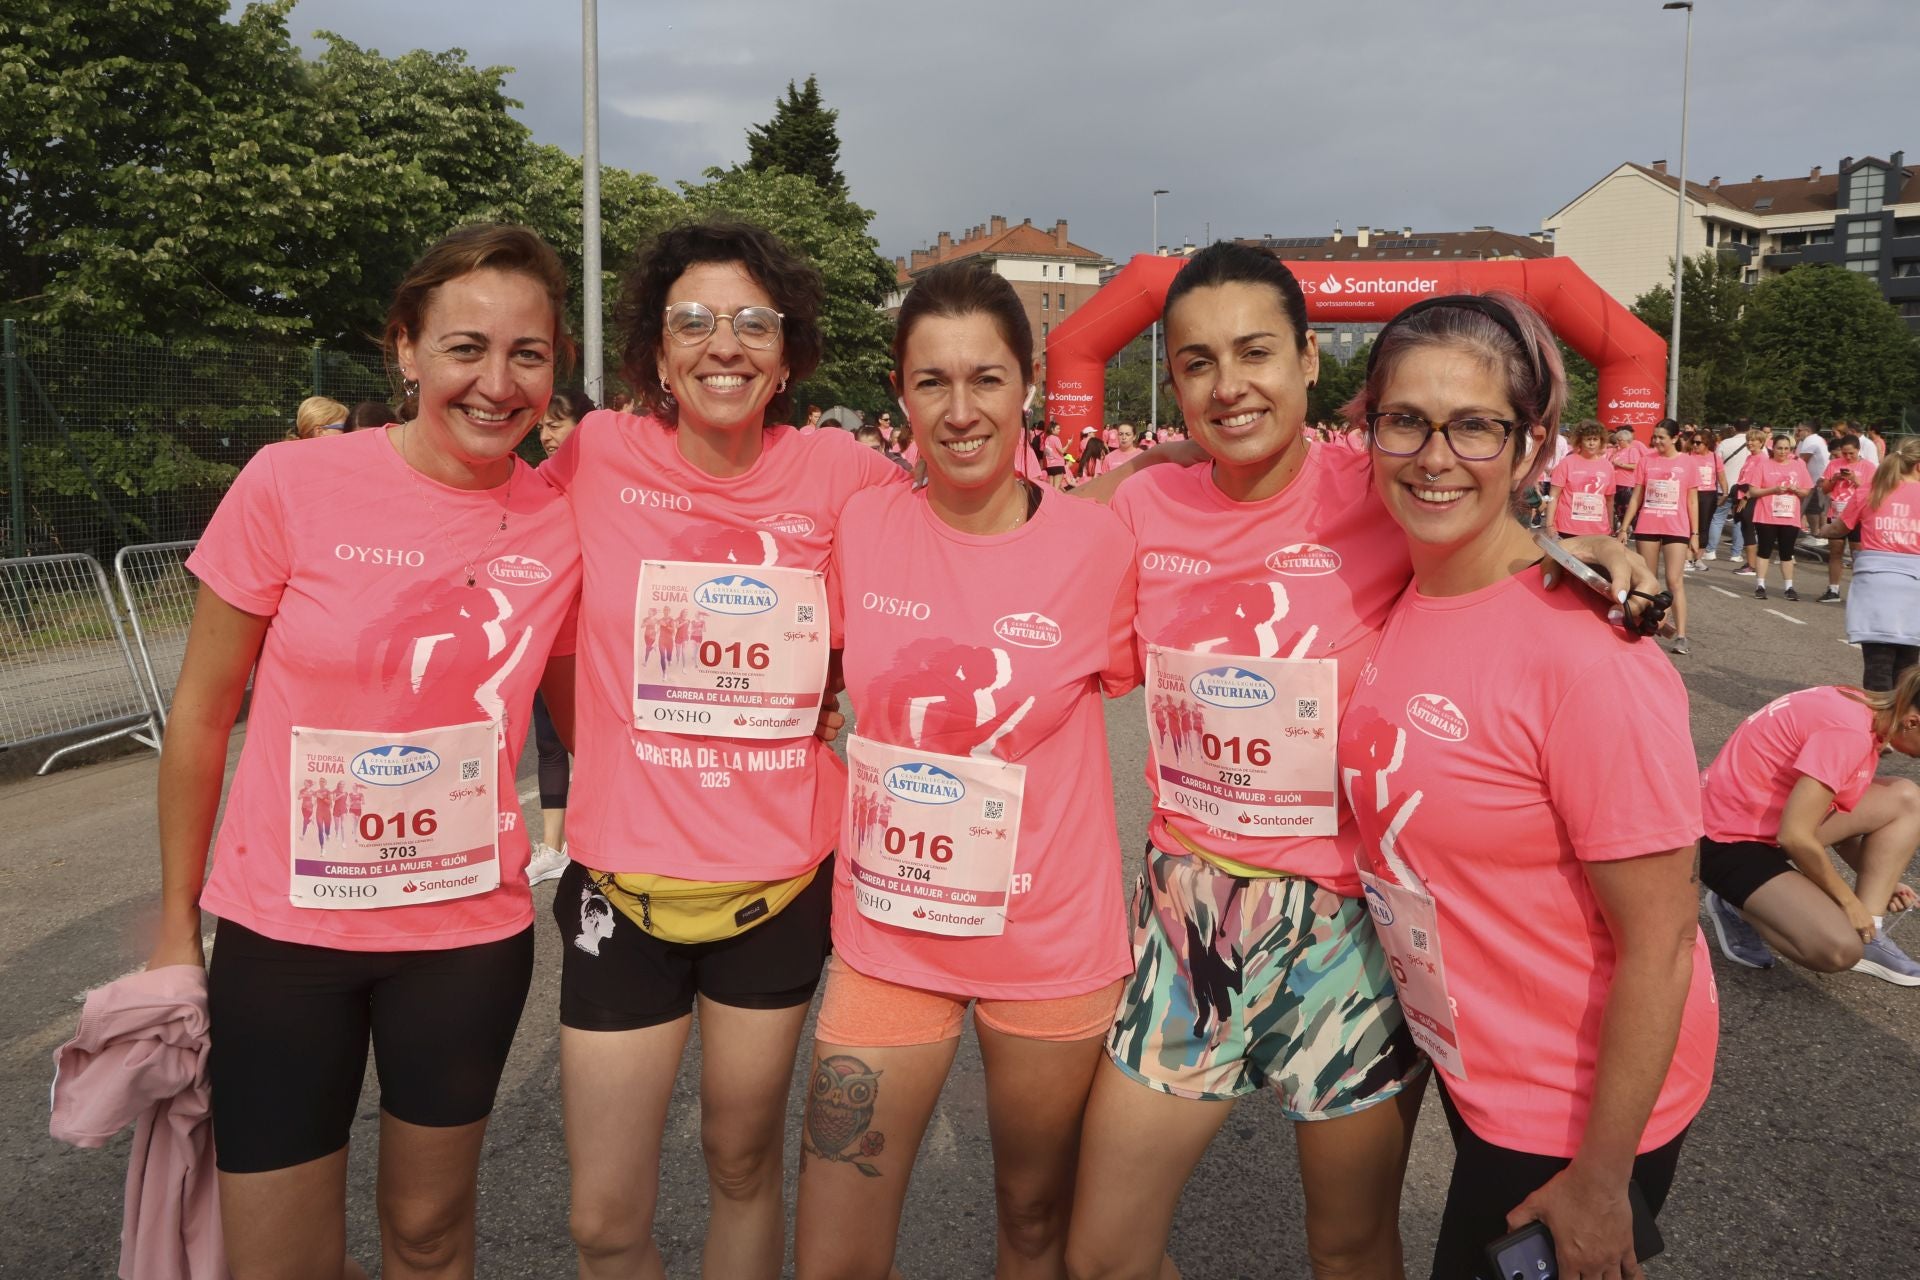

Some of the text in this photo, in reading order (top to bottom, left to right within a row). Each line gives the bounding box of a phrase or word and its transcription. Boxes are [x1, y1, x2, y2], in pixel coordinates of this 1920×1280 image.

[1345, 277, 1438, 294] Santander
[1057, 381, 1082, 389] Sports
[1622, 386, 1651, 396] Sports
[1055, 393, 1093, 402] Santander
[1619, 401, 1661, 409] Santander
[620, 487, 692, 512] OYSHO
[1891, 502, 1910, 517] TU
[1882, 531, 1917, 546] SUMA
[335, 544, 424, 567] OYSHO
[1143, 552, 1211, 575] OYSHO
[1272, 555, 1336, 569] ASTURIANA
[492, 563, 546, 579] ASTURIANA
[652, 591, 689, 603] SUMA
[700, 589, 772, 607] ASTURIANA
[863, 592, 930, 621] OYSHO
[999, 621, 1057, 643] ASTURIANA
[700, 640, 770, 670] 016
[716, 676, 750, 689] 2375
[1157, 678, 1186, 693] SUMA
[1196, 679, 1269, 700] ASTURIANA
[666, 690, 795, 706] CARRERA DE LA MUJER GIJÓN
[654, 707, 711, 724] OYSHO
[749, 717, 800, 728] Santander
[1409, 700, 1462, 739] ASTURIANA
[307, 754, 345, 763] TU DORSAL
[631, 739, 806, 771] ARRERA DE LA MUJER
[1202, 733, 1271, 767] 016
[307, 761, 345, 775] SUMA
[357, 758, 434, 776] ASTURIANA
[701, 772, 730, 788] 2025
[857, 768, 879, 785] SUMA
[1219, 771, 1251, 786] 2792
[888, 772, 959, 799] ASTURIANA
[1181, 775, 1302, 803] CARRERA DE LA MUJER GIJÓN
[1175, 791, 1219, 816] OYSHO
[359, 808, 437, 841] 016
[1253, 814, 1314, 826] Santander
[379, 846, 417, 859] 3703
[884, 827, 954, 863] 016
[325, 855, 467, 875] CARRERA DE LA MUJER GIJÓN
[897, 865, 931, 882] 3704
[313, 884, 377, 898] OYSHO
[419, 874, 479, 891] Santander
[859, 870, 977, 903] CARRERA DE LA MUJER GIJÓN
[856, 886, 891, 911] OYSHO
[928, 910, 985, 926] Santander
